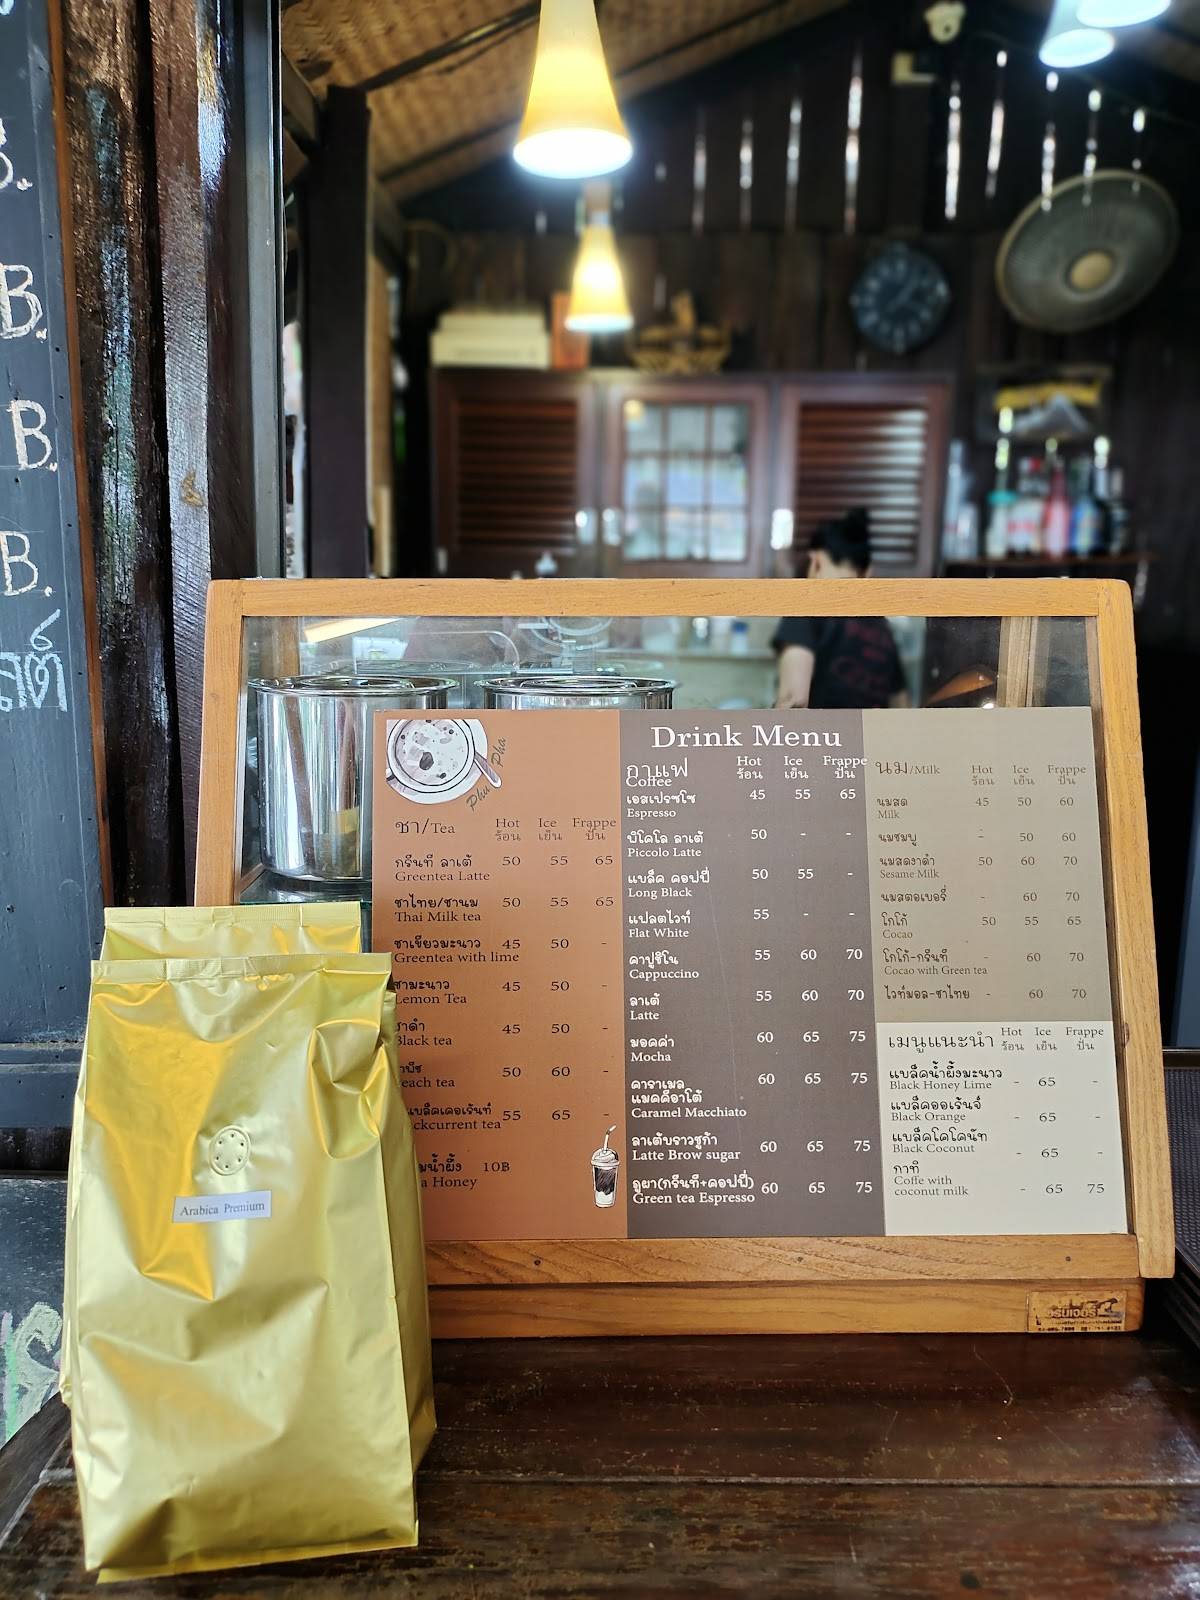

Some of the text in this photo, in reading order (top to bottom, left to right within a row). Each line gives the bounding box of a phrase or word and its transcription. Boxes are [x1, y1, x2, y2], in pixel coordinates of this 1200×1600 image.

[651, 724, 843, 749] Drink Menu
[736, 755, 762, 767] Hot
[784, 755, 803, 767] Ice
[823, 755, 868, 769] Frappe
[971, 764, 1087, 777] Hot Ice Frappe
[625, 776, 673, 788] Coffee
[749, 788, 856, 800] 45 55 65
[974, 797, 990, 807] 45
[1017, 797, 1032, 808] 50
[1059, 797, 1074, 807] 60
[626, 808, 677, 820] Espresso
[877, 809, 900, 820] Milk
[495, 817, 521, 829] Hot
[539, 817, 558, 828] Ice
[573, 817, 618, 831] Frappe
[750, 829, 768, 841] 50
[1019, 832, 1077, 842] 50 60
[627, 848, 702, 858] Piccolo Latte
[502, 856, 522, 867] 50
[550, 856, 569, 867] 55
[595, 856, 614, 866] 65
[978, 856, 1079, 867] 50 60 70
[395, 871, 491, 882] Greentea Latte
[751, 869, 814, 880] 50 55
[879, 869, 940, 879] Sesame Milk
[628, 887, 693, 901] Long Black
[1023, 892, 1081, 902] 60 70
[502, 897, 522, 909] 50
[550, 897, 569, 908] 55
[595, 897, 614, 908] 65
[394, 911, 482, 923] Thai Milk tea
[753, 908, 770, 920] 55
[982, 916, 997, 927] 50
[1024, 916, 1040, 926] 55
[1067, 916, 1082, 926] 65
[628, 927, 690, 939] Flat White
[882, 929, 914, 940] Cocao
[502, 938, 522, 950] 45
[550, 938, 570, 950] 50
[394, 951, 520, 964] Greentea with lime
[754, 948, 864, 961] 55 60 70
[1026, 952, 1085, 963] 60 70
[629, 968, 700, 981] Cappuccino
[884, 965, 988, 977] Cocao with Green tea
[502, 980, 570, 992] 45 50
[395, 993, 468, 1005] Lemon Tea
[755, 990, 773, 1002] 55
[801, 989, 819, 1001] 60
[847, 989, 865, 1001] 70
[1028, 988, 1087, 1000] 60 70
[630, 1010, 661, 1021] Latte
[502, 1023, 571, 1035] 45 50
[1000, 1026, 1023, 1037] Hot
[1034, 1026, 1052, 1037] Ice
[1065, 1026, 1105, 1039] Frappe
[433, 1035, 453, 1046] tea
[756, 1031, 774, 1044] 60
[803, 1031, 820, 1043] 65
[849, 1030, 867, 1043] 75
[631, 1051, 672, 1063] Mocha
[502, 1066, 571, 1078] 50 60
[436, 1077, 456, 1088] tea
[758, 1073, 775, 1086] 60
[804, 1072, 822, 1085] 65
[850, 1072, 868, 1085] 75
[889, 1076, 1057, 1093] Black Honey Lime 65
[502, 1109, 572, 1121] 55 65
[631, 1107, 748, 1118] Caramel Macchiato
[891, 1111, 1057, 1124] Black Orange 65
[482, 1119, 502, 1130] tea
[760, 1139, 872, 1153] 60 65 75
[893, 1143, 1060, 1159] Black Coconut 65
[632, 1149, 742, 1163] Latte Brow sugar
[482, 1161, 511, 1173] 10B
[432, 1176, 477, 1190] Honey
[894, 1175, 953, 1186] Coffe with
[761, 1181, 873, 1194] 60 65 75
[894, 1182, 1105, 1197] coconut milk 65 75
[632, 1192, 756, 1207] Green tea Espresso
[180, 1201, 265, 1217] Arabica Premium
